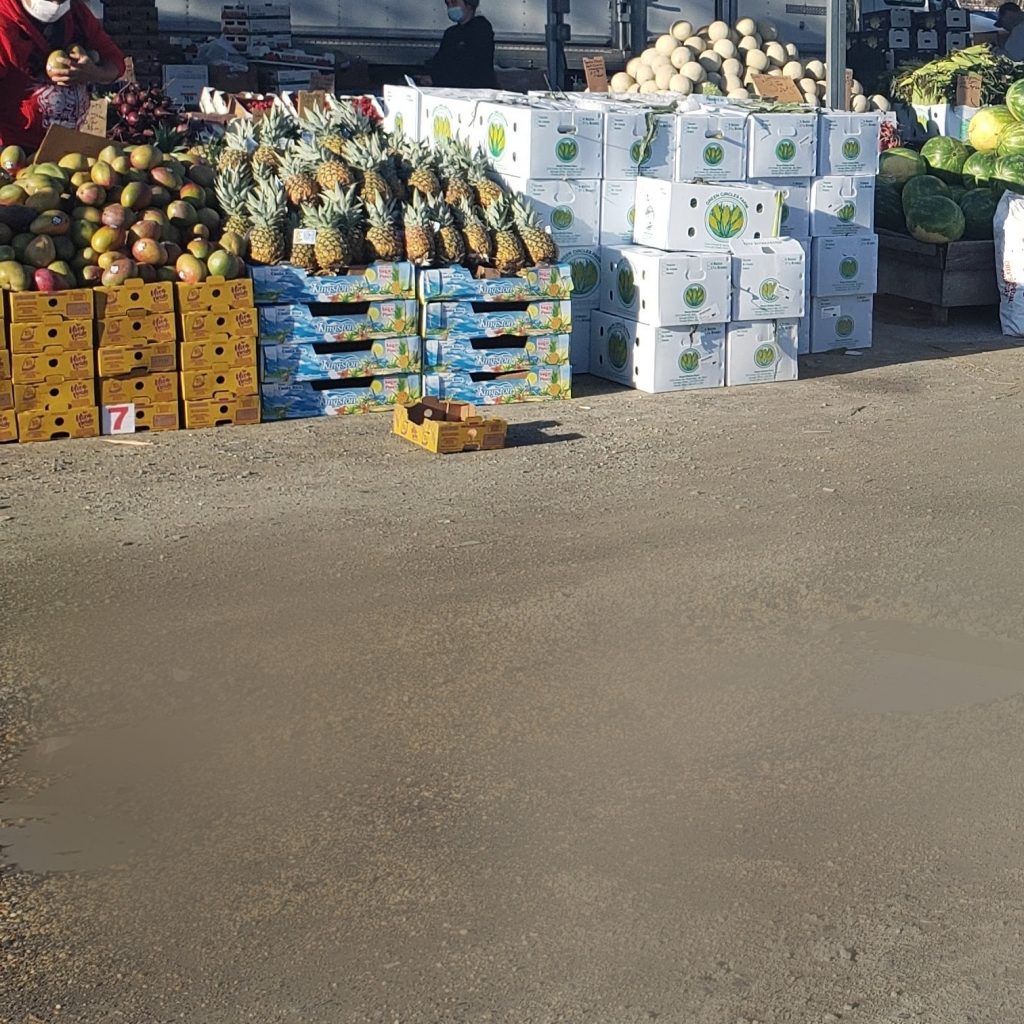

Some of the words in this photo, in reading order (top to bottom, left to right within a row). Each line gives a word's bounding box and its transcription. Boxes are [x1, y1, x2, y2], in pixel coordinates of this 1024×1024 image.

[311, 282, 352, 295] Kingston
[316, 321, 356, 334] Kingston
[479, 318, 515, 331] Kingston
[320, 359, 360, 371] Kingston
[478, 386, 514, 398] Kingston
[319, 394, 357, 407] Kingston
[108, 407, 129, 430] 7
